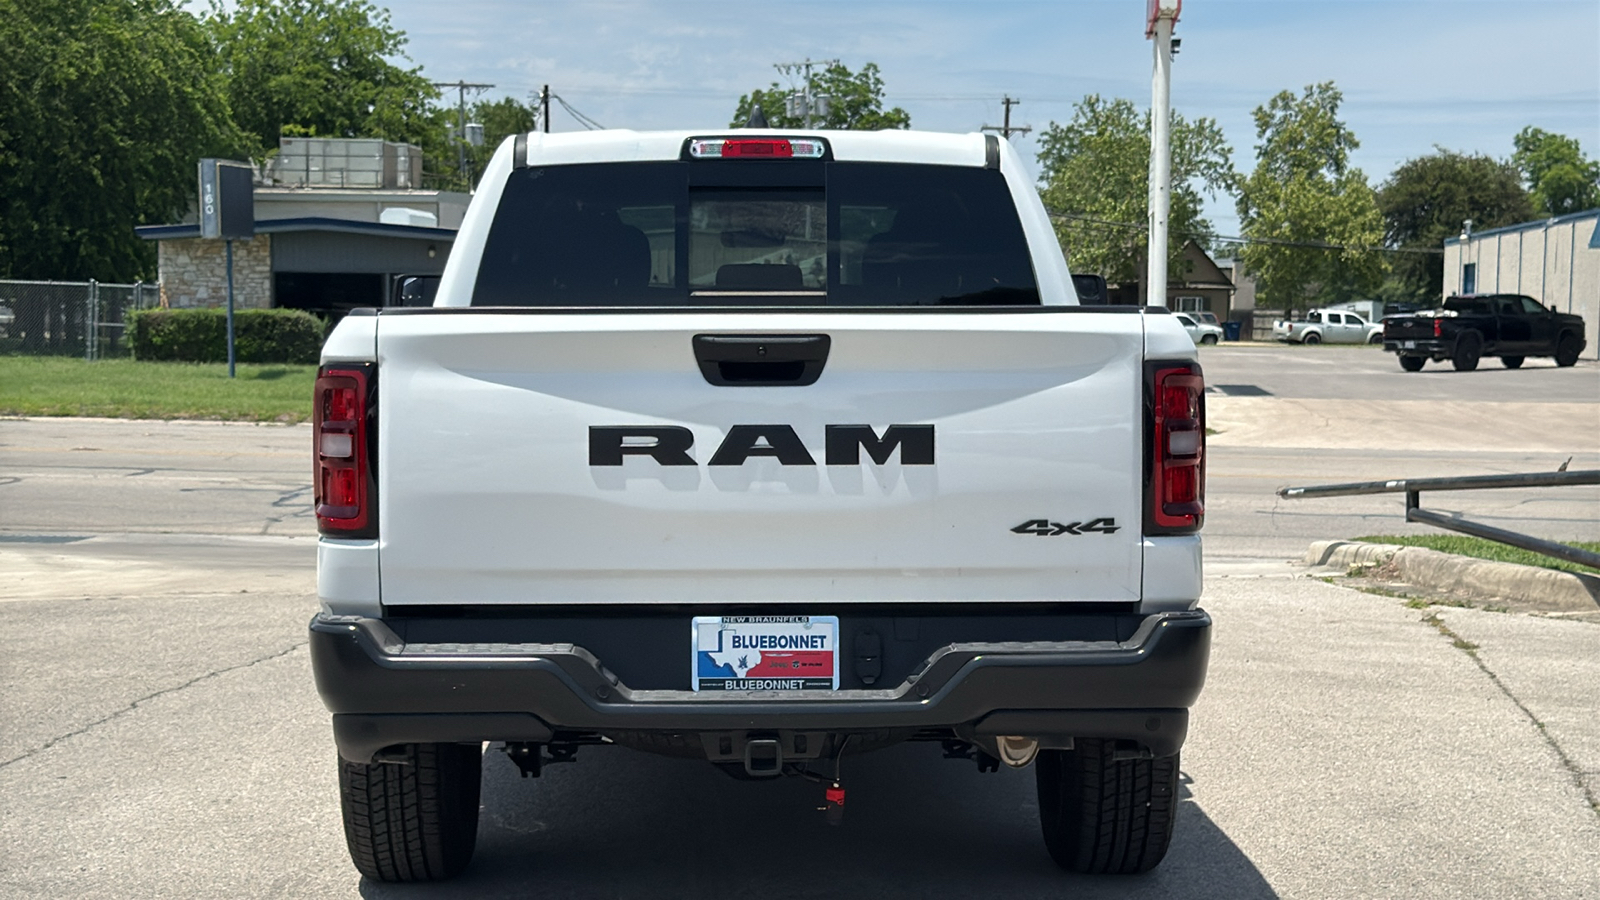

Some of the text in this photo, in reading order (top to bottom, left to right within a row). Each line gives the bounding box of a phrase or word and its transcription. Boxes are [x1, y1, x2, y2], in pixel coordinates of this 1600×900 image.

[205, 183, 214, 215] 160
[589, 424, 935, 466] RAM
[1009, 518, 1121, 536] 4x4
[732, 635, 827, 649] BLUEBONNET
[725, 680, 805, 690] BLUEBONNET
